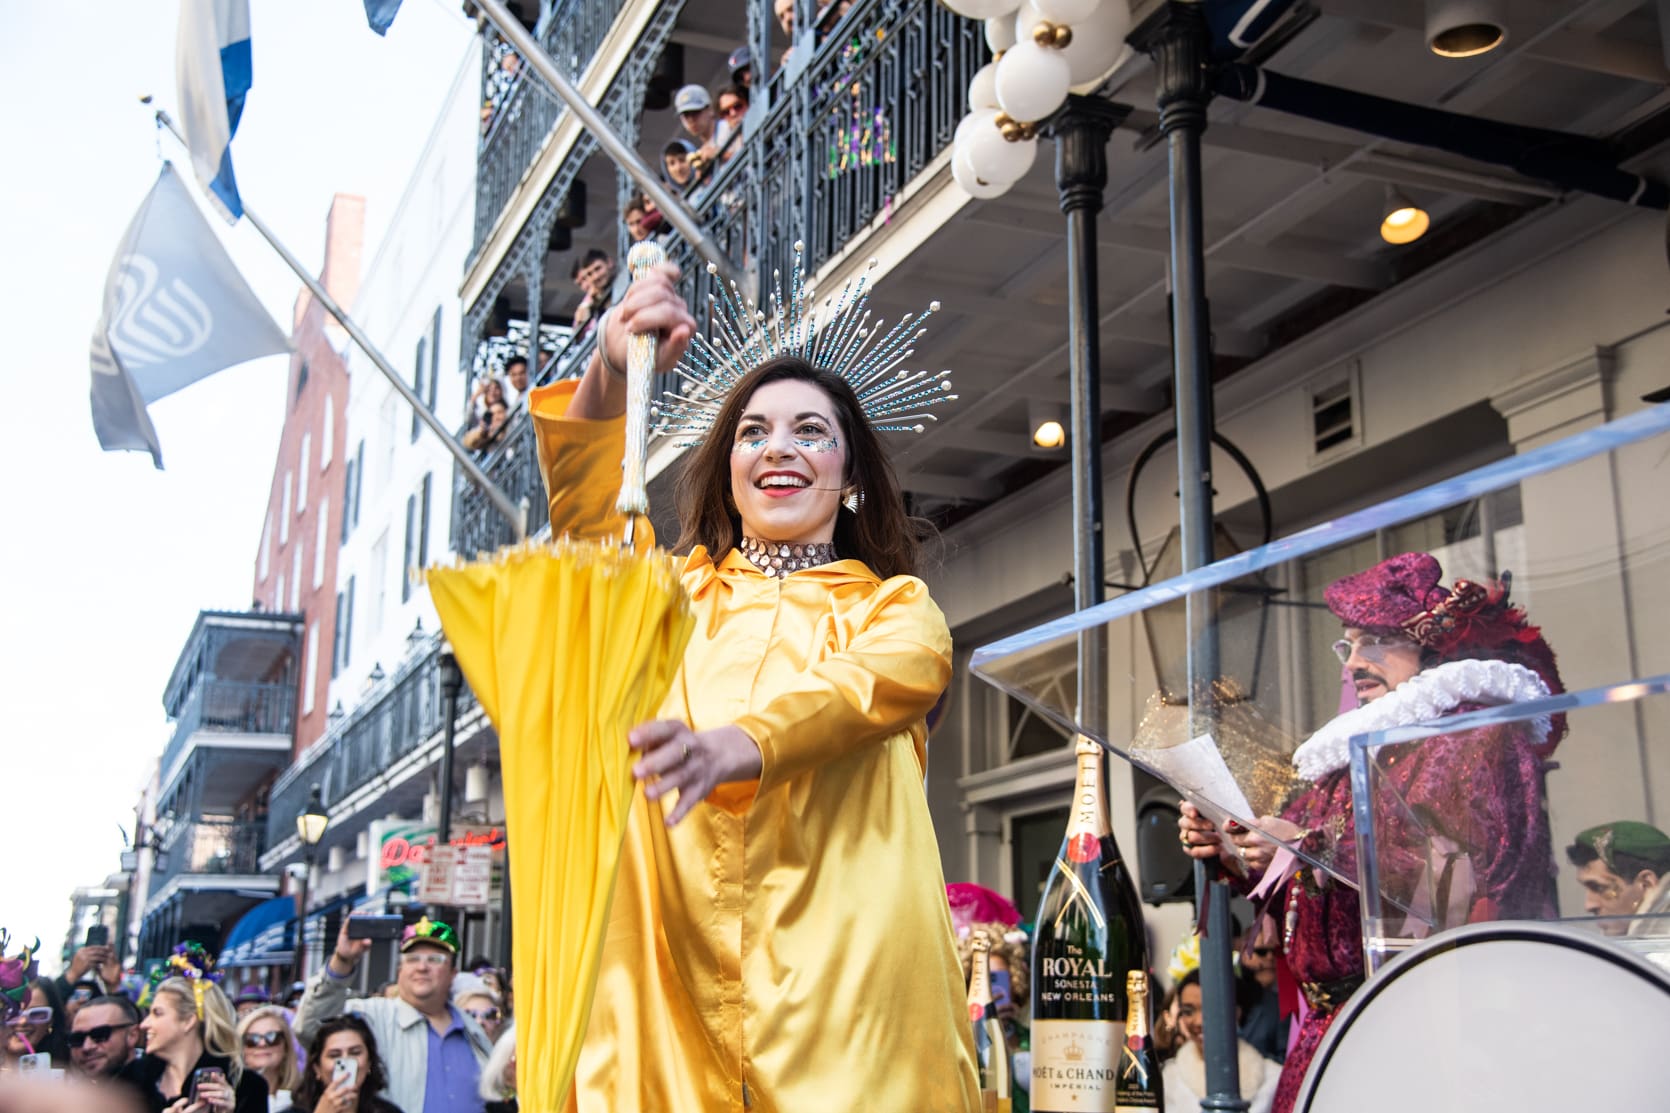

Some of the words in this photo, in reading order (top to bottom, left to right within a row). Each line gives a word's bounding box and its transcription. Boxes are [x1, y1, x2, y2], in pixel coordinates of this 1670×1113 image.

[1066, 945, 1082, 955] The
[1043, 957, 1113, 978] ROYAL
[1054, 979, 1098, 989] SONESTA
[1041, 992, 1061, 1001] NEW
[1064, 992, 1115, 1002] ORLEANS
[1042, 1031, 1113, 1046] CHAMPAGNE
[1056, 1070, 1063, 1079] &
[1066, 1068, 1115, 1081] CHAND
